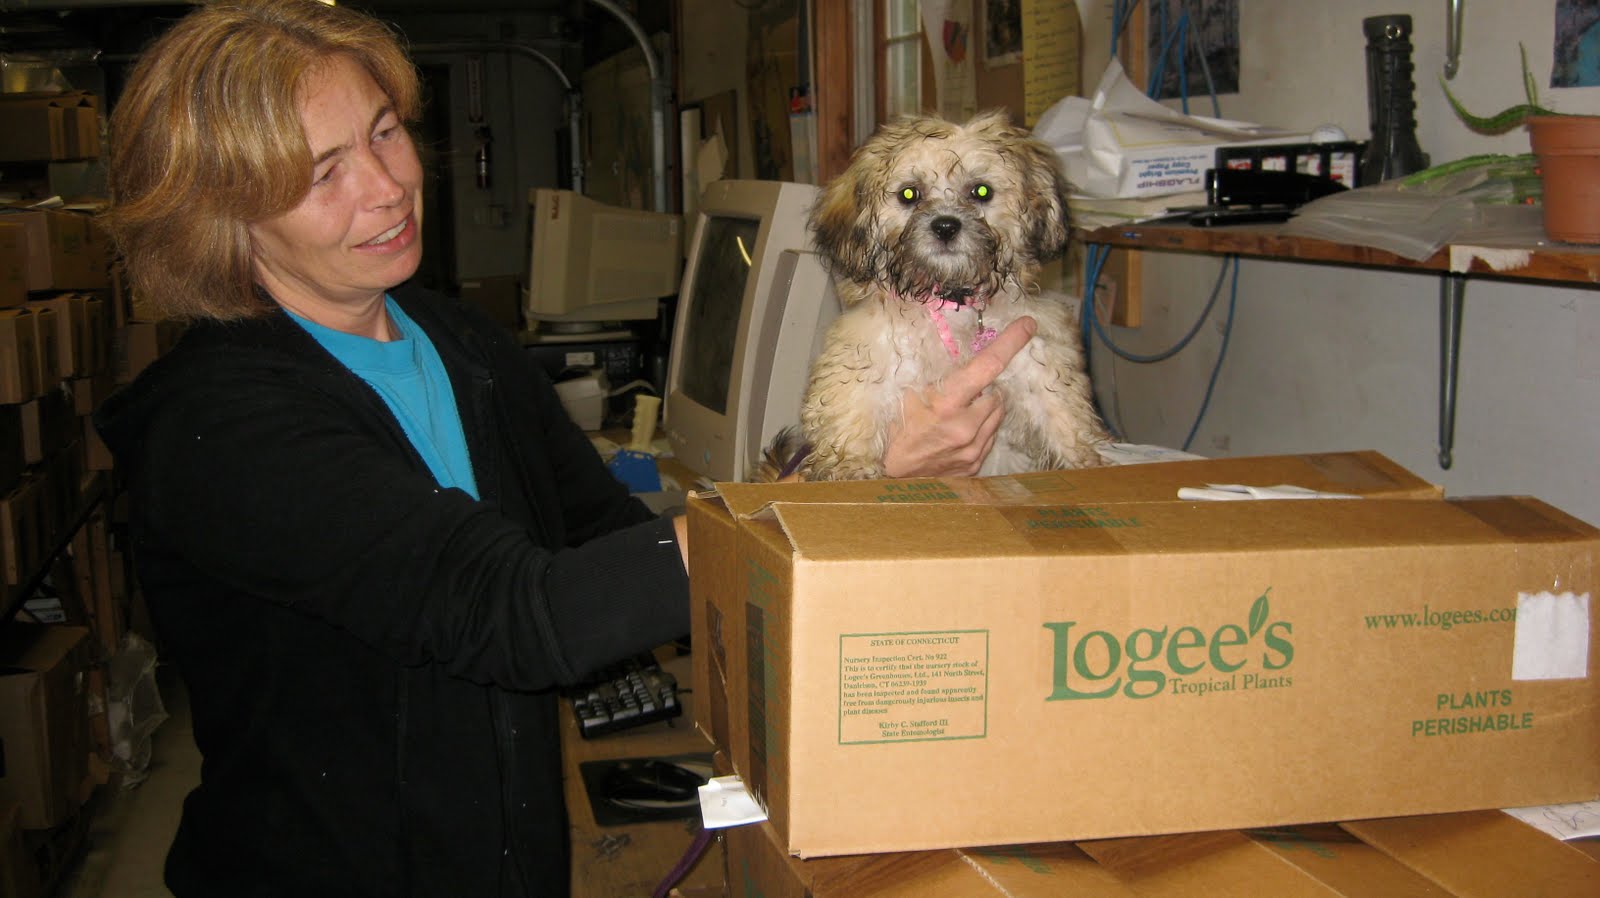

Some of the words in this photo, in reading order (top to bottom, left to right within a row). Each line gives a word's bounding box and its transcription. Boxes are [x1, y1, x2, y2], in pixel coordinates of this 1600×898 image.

[1137, 178, 1200, 189] FLAGSHIP
[884, 482, 949, 492] PLANTS
[875, 491, 960, 502] PERISHAB
[1036, 507, 1109, 517] PLANTS
[1024, 517, 1146, 528] PERISHABLE
[907, 637, 960, 645] CONNECTICUT
[1042, 586, 1295, 702] Logee's
[1169, 675, 1236, 696] Tropical
[1243, 673, 1293, 690] Plants
[874, 690, 904, 698] inspected
[942, 687, 976, 695] apparently
[916, 696, 946, 704] injurious
[1437, 690, 1513, 710] PLANTS
[879, 722, 899, 730] Kirby
[1411, 713, 1535, 737] PERISHABLE
[901, 728, 945, 736] Entomologist
